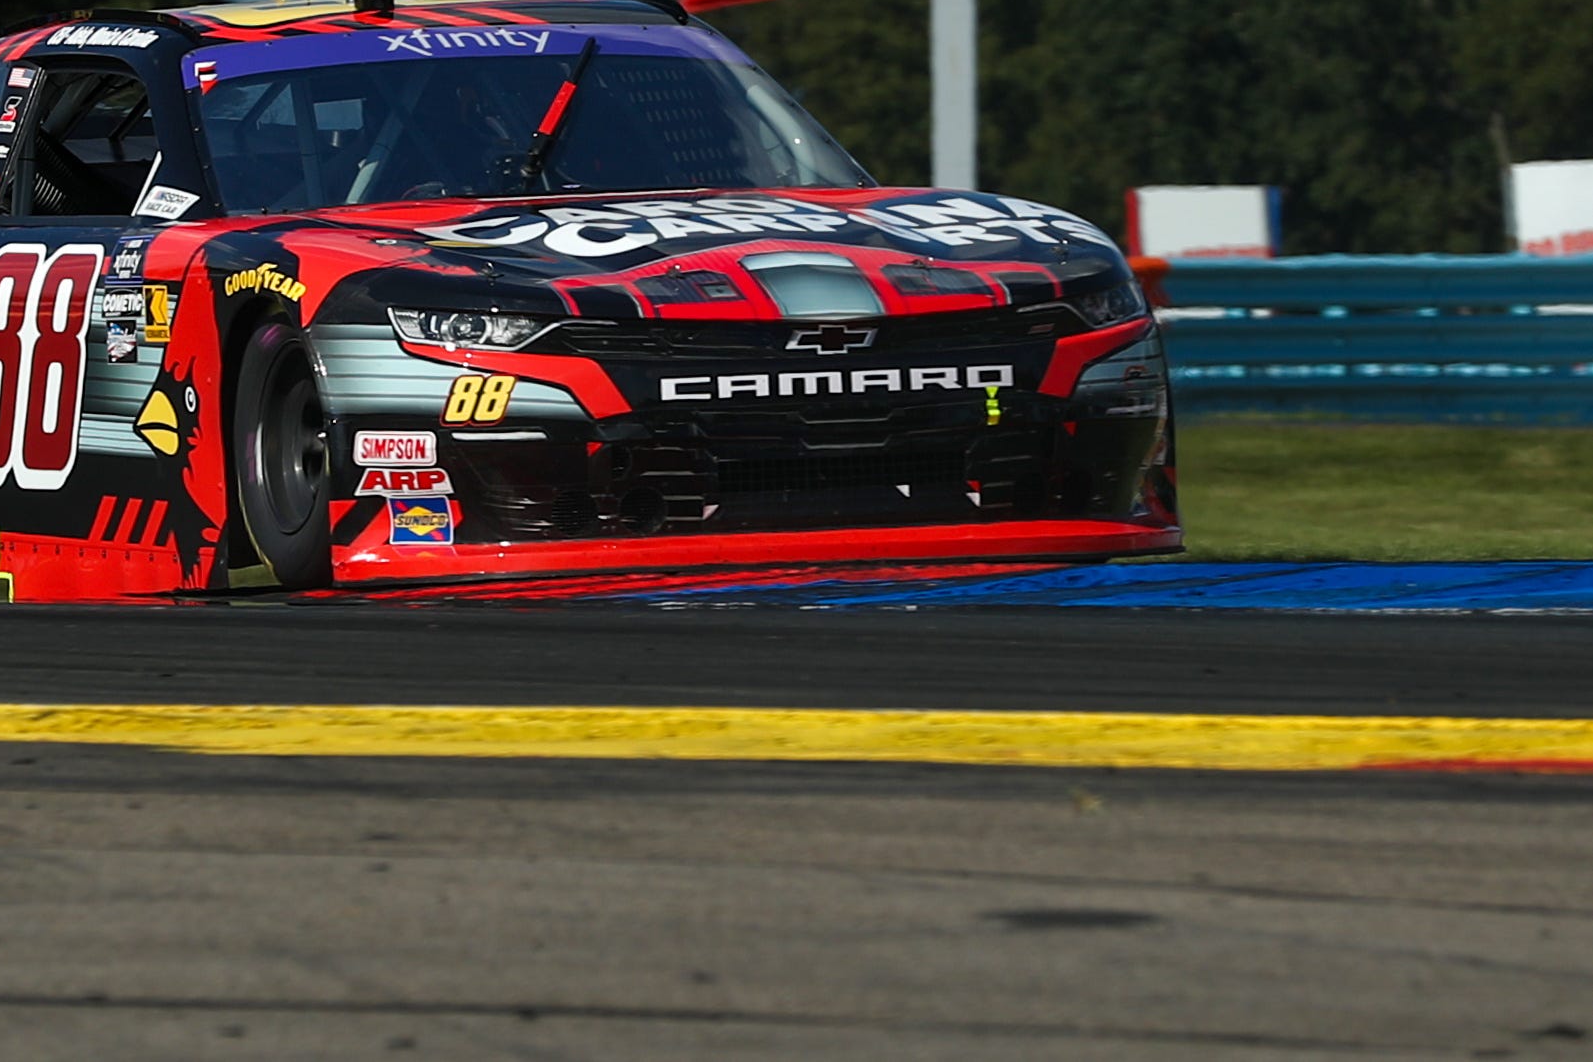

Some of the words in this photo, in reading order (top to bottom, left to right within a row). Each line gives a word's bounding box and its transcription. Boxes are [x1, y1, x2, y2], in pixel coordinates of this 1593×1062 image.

[378, 27, 551, 57] xfinity
[224, 262, 307, 303] GOODYEAR
[660, 364, 1014, 401] CAMARO
[441, 375, 516, 426] 88
[360, 437, 427, 460] SIMPSON
[359, 469, 446, 491] ARP
[395, 514, 448, 527] SUNOCO
